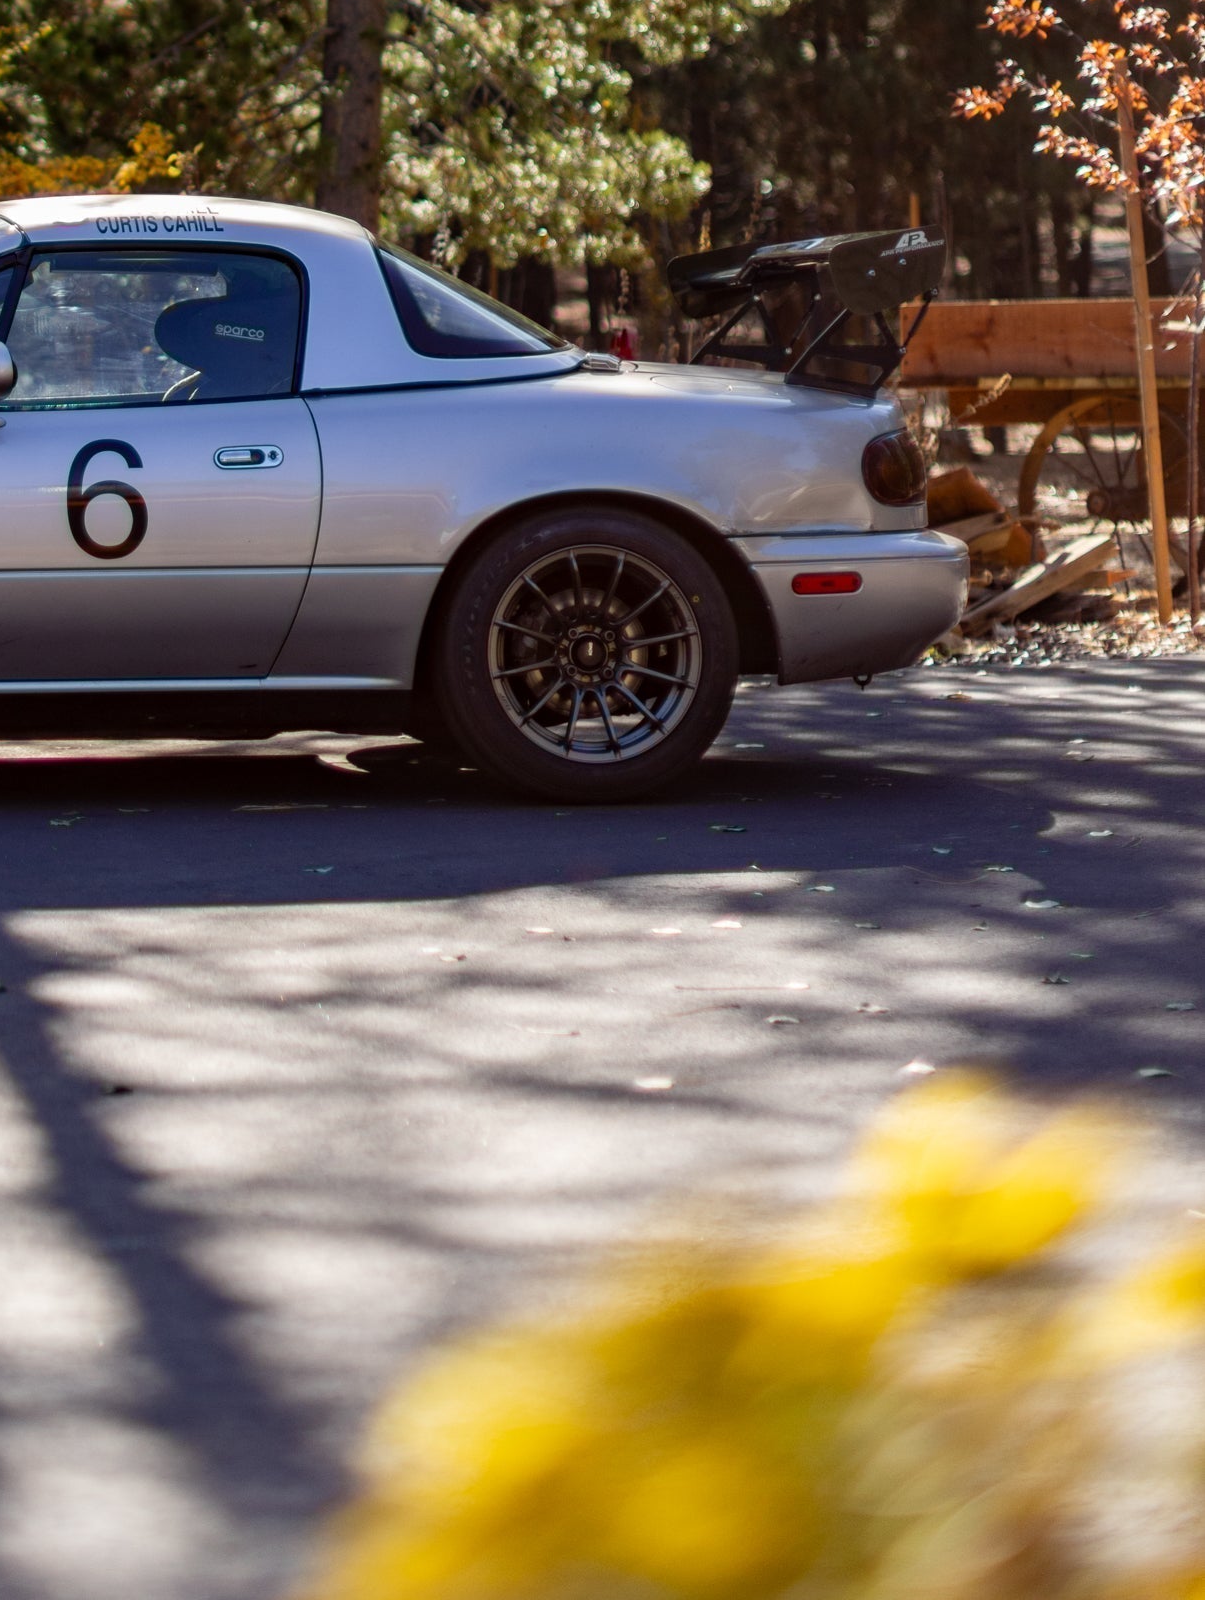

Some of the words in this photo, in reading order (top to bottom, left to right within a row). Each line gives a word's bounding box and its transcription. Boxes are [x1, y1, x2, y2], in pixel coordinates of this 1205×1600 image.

[96, 215, 158, 234] CURTIS
[162, 215, 224, 233] CAHILL
[215, 324, 265, 339] sparco
[66, 438, 149, 560] 6
